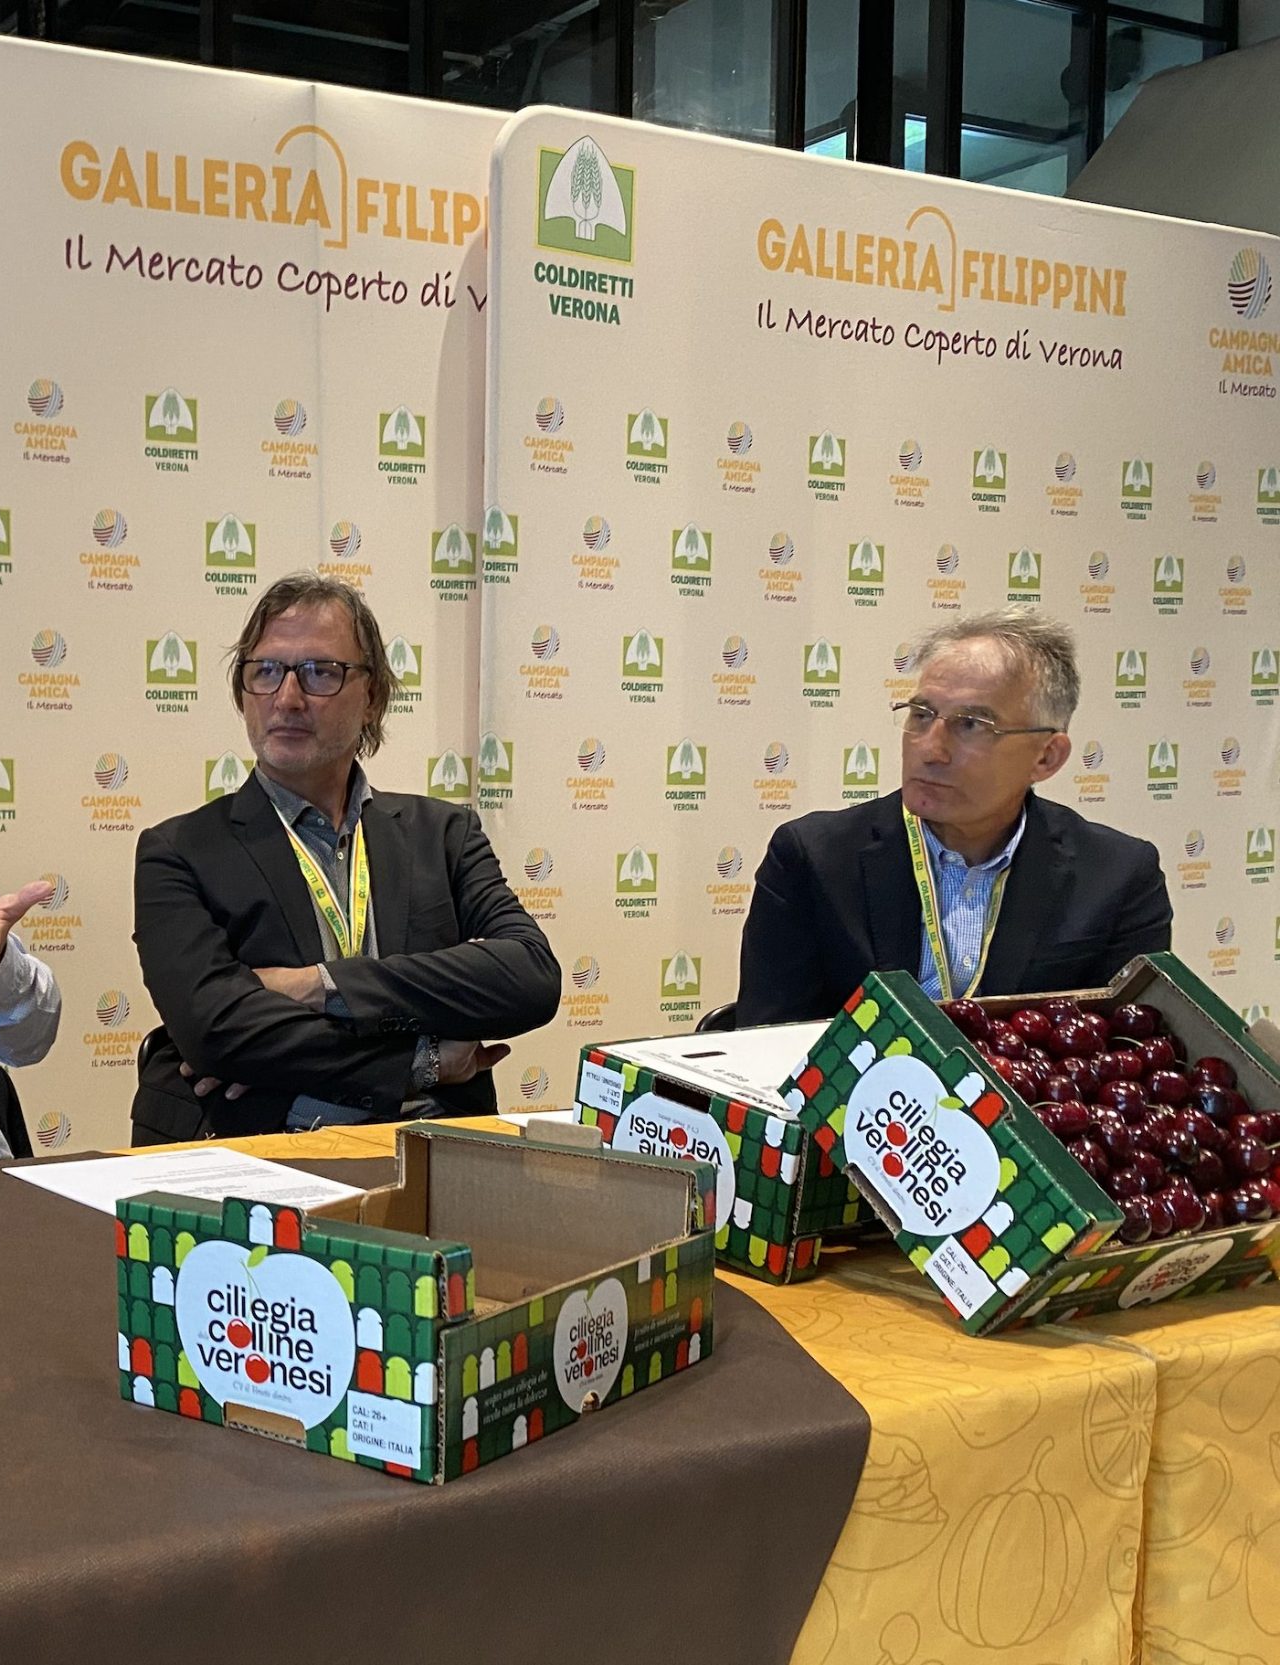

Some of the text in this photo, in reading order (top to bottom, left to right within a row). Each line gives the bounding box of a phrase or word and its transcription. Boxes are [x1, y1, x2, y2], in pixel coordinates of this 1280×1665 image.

[59, 140, 487, 247] GALLERIA FILIP
[65, 236, 91, 271] Il
[105, 244, 263, 290] Mercato
[278, 261, 409, 312] Coperto
[421, 272, 456, 309] di
[758, 218, 1127, 317] GALLERIA FILIPPINI
[534, 262, 633, 299] COLDIRETTI
[549, 293, 620, 326] VERONA
[757, 302, 1123, 371] Il Mercato Coperto di Verona
[1209, 327, 1280, 353] CAMPAGN
[1222, 353, 1273, 376] AMICA
[1230, 382, 1276, 398] Mercato
[14, 422, 77, 440] CAMPAGNA
[26, 436, 66, 452] AMICA
[261, 441, 318, 456] CAMPAGNA
[524, 436, 574, 452] CAMPAGNA
[145, 447, 198, 460] COLDIRETTI
[271, 453, 308, 468] AMICA
[532, 449, 567, 464] AMICA
[156, 462, 188, 471] VERONA
[378, 461, 425, 473] COLDIRETTI
[626, 461, 667, 473] COLDIRETTI
[388, 476, 417, 484] VERONA
[79, 553, 140, 569] CAMPAGNA
[90, 566, 129, 581] AMICA
[205, 573, 256, 583] COLDIRETTI
[671, 575, 711, 586] COLDIRETTI
[215, 587, 247, 595] VERONA
[621, 682, 663, 692] COLDIRETTI
[146, 690, 197, 700] COLDIRETTI
[156, 704, 188, 712] VERONA
[665, 791, 706, 799] COLDIRETTI
[81, 796, 141, 810] CAMPAGNA
[92, 808, 131, 820] AMICA
[615, 898, 657, 907] COLDIRETTI
[19, 915, 82, 928] CAMPAGNA
[32, 928, 71, 940] AMICA
[83, 1032, 143, 1046] CAMPAGNA
[94, 1044, 132, 1056] AMICA
[889, 1090, 967, 1186] ciliegia
[207, 1284, 318, 1334] ciliegia
[570, 1307, 614, 1342] ciliegia
[388, 1441, 413, 1454] ITALIA
